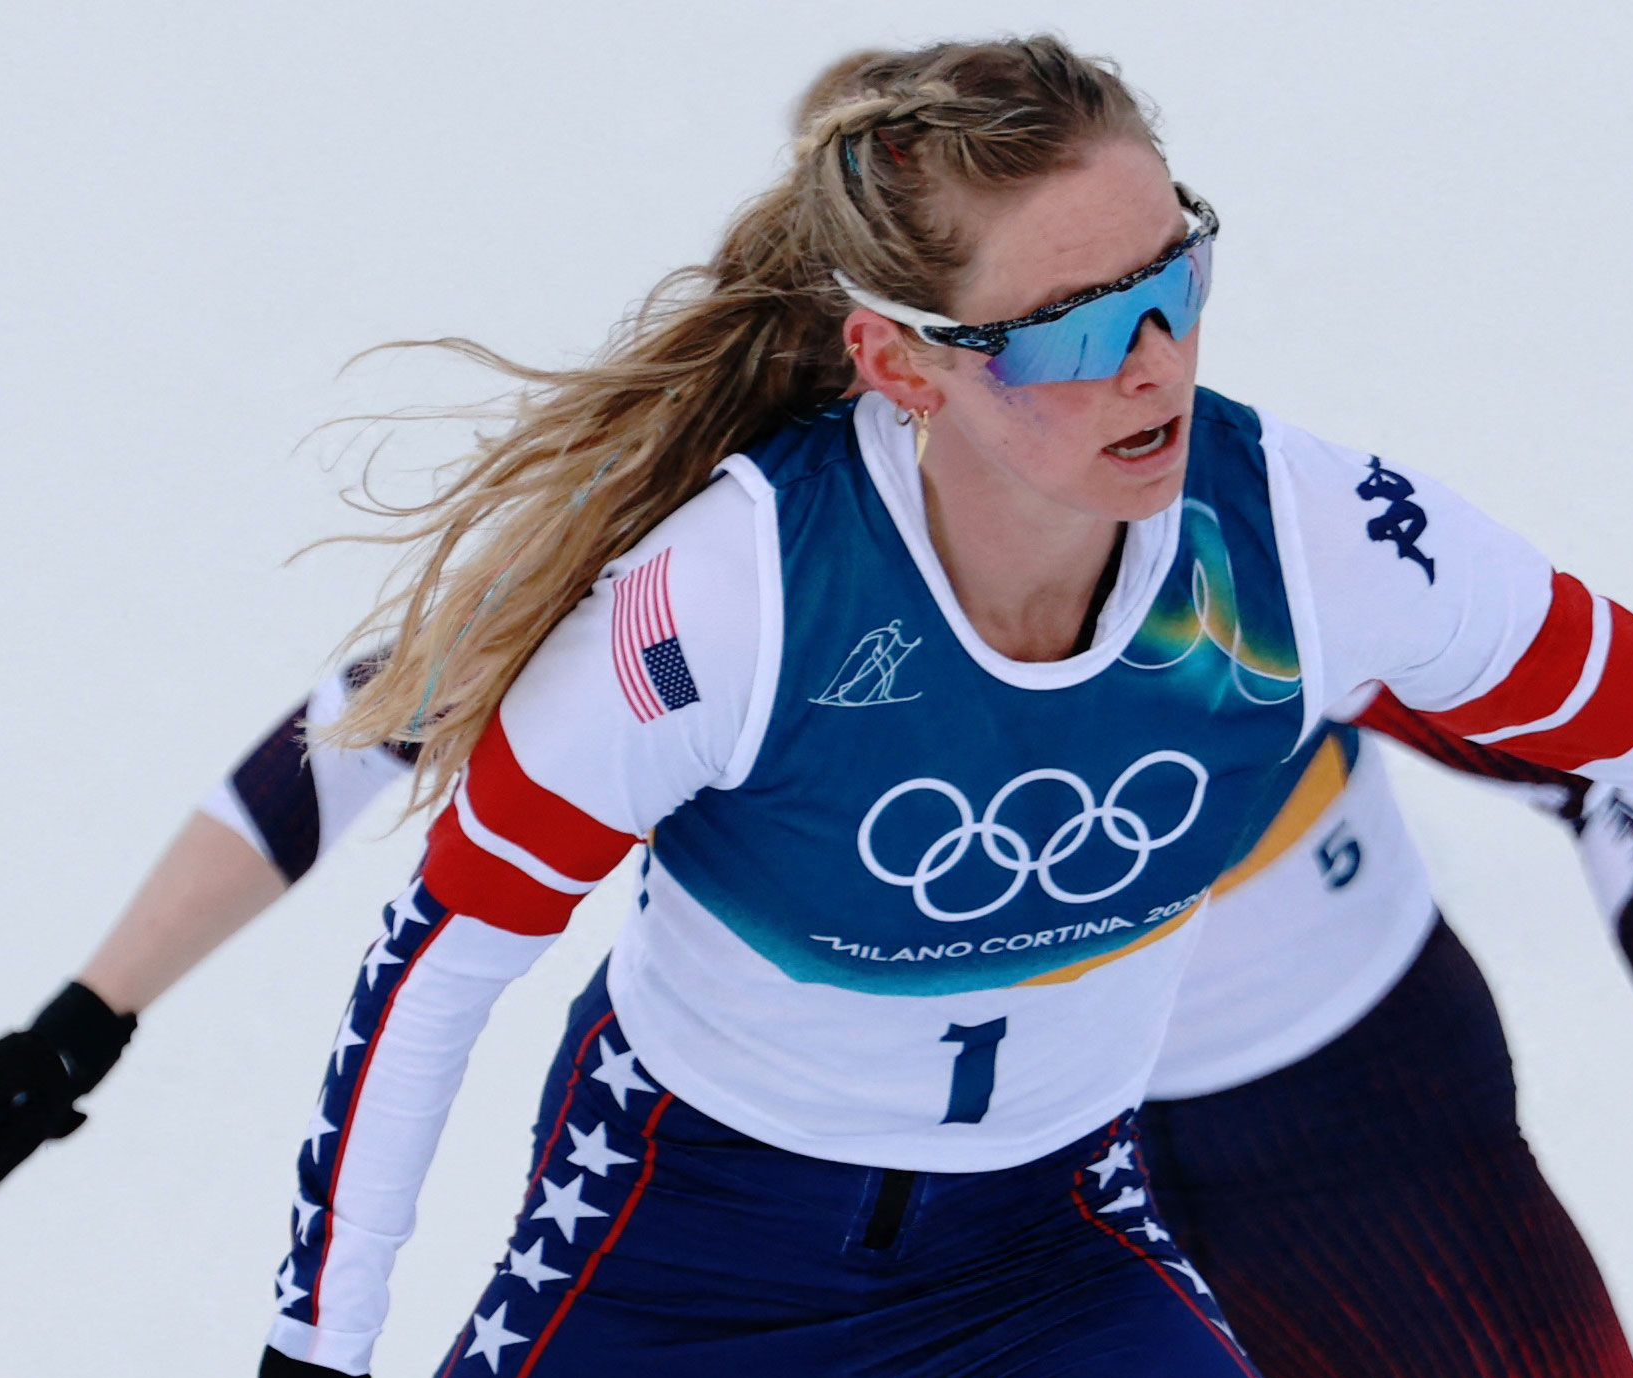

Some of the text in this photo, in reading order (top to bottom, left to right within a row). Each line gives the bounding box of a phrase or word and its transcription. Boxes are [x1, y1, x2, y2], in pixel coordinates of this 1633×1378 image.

[1314, 818, 1361, 889] 5
[809, 934, 974, 962] MILANO
[979, 915, 1136, 954] CORTINA
[939, 1016, 1007, 1125] 1
